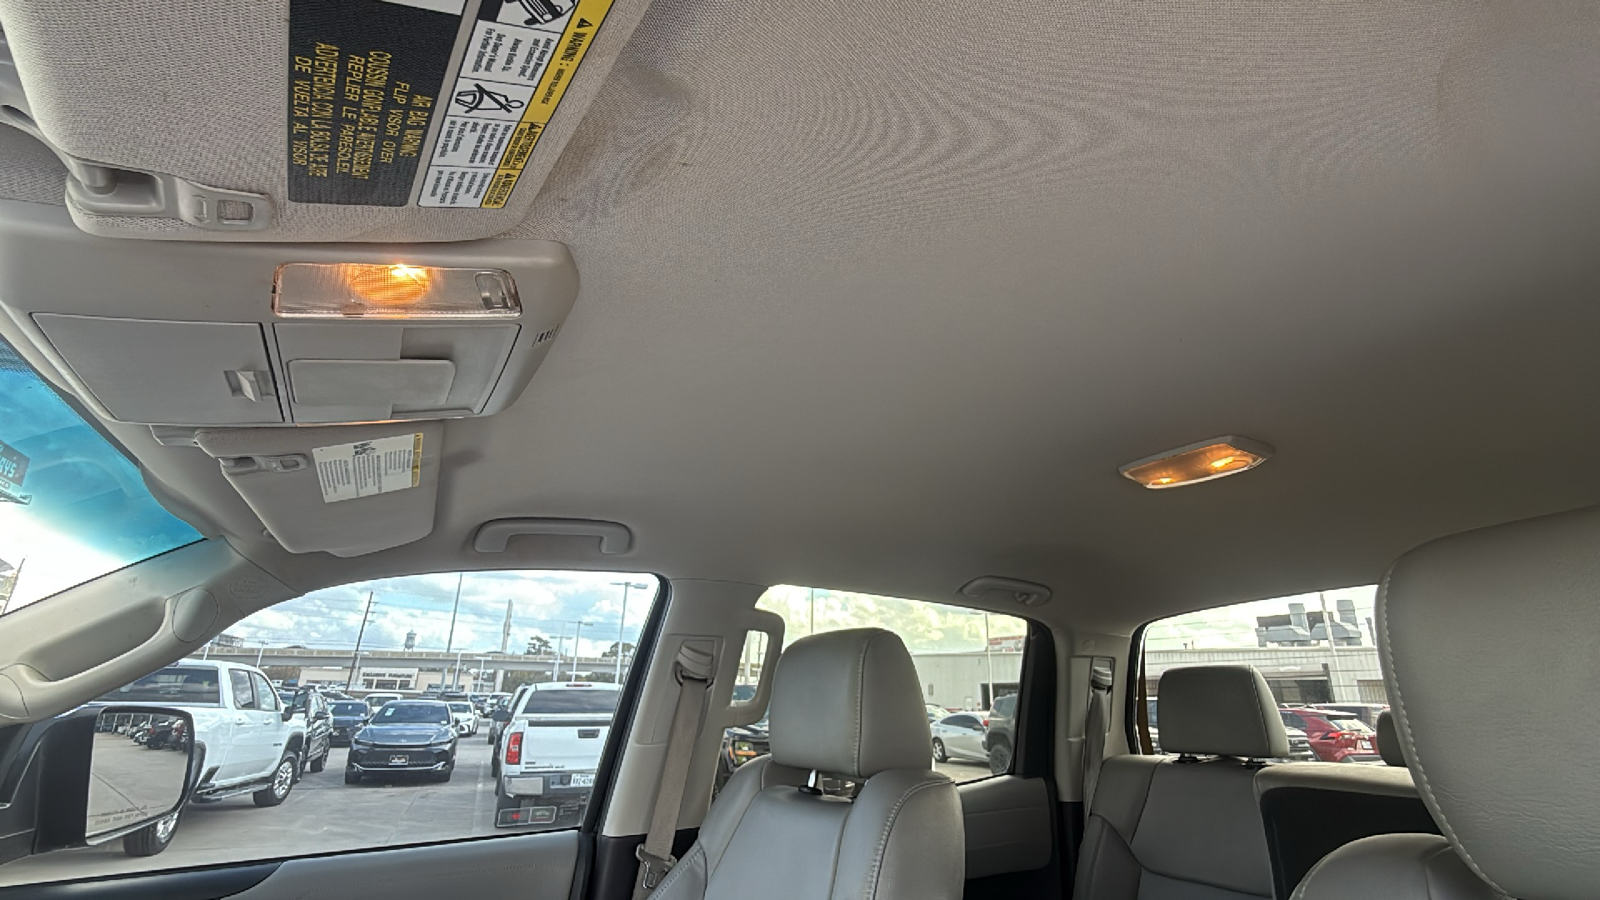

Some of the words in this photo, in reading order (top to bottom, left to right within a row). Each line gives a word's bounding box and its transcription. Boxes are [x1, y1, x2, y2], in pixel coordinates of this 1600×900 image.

[561, 32, 588, 62] WARNING
[295, 55, 312, 74] DE
[313, 42, 339, 100] ADVERTENCIA
[365, 51, 393, 88] COUSSIN
[344, 54, 365, 102] REPLIER
[293, 80, 310, 118] VUELTA
[393, 81, 410, 105] FLIP
[412, 94, 433, 108] AIR
[311, 101, 334, 119] CON
[342, 106, 357, 120] LE
[357, 89, 384, 132] GONFLABLE
[407, 110, 429, 126] BAG
[293, 121, 309, 134] AL
[310, 119, 332, 129] LA
[385, 109, 404, 136] VISOR
[292, 140, 308, 166] VISOR
[309, 130, 331, 154] BOLSA
[336, 123, 356, 174] PARESOLEIL
[380, 140, 396, 164] OVER
[399, 129, 424, 158] WARNING
[309, 154, 329, 164] DE
[352, 132, 375, 179] AVERTISSEMENT
[308, 164, 328, 178] AIRE
